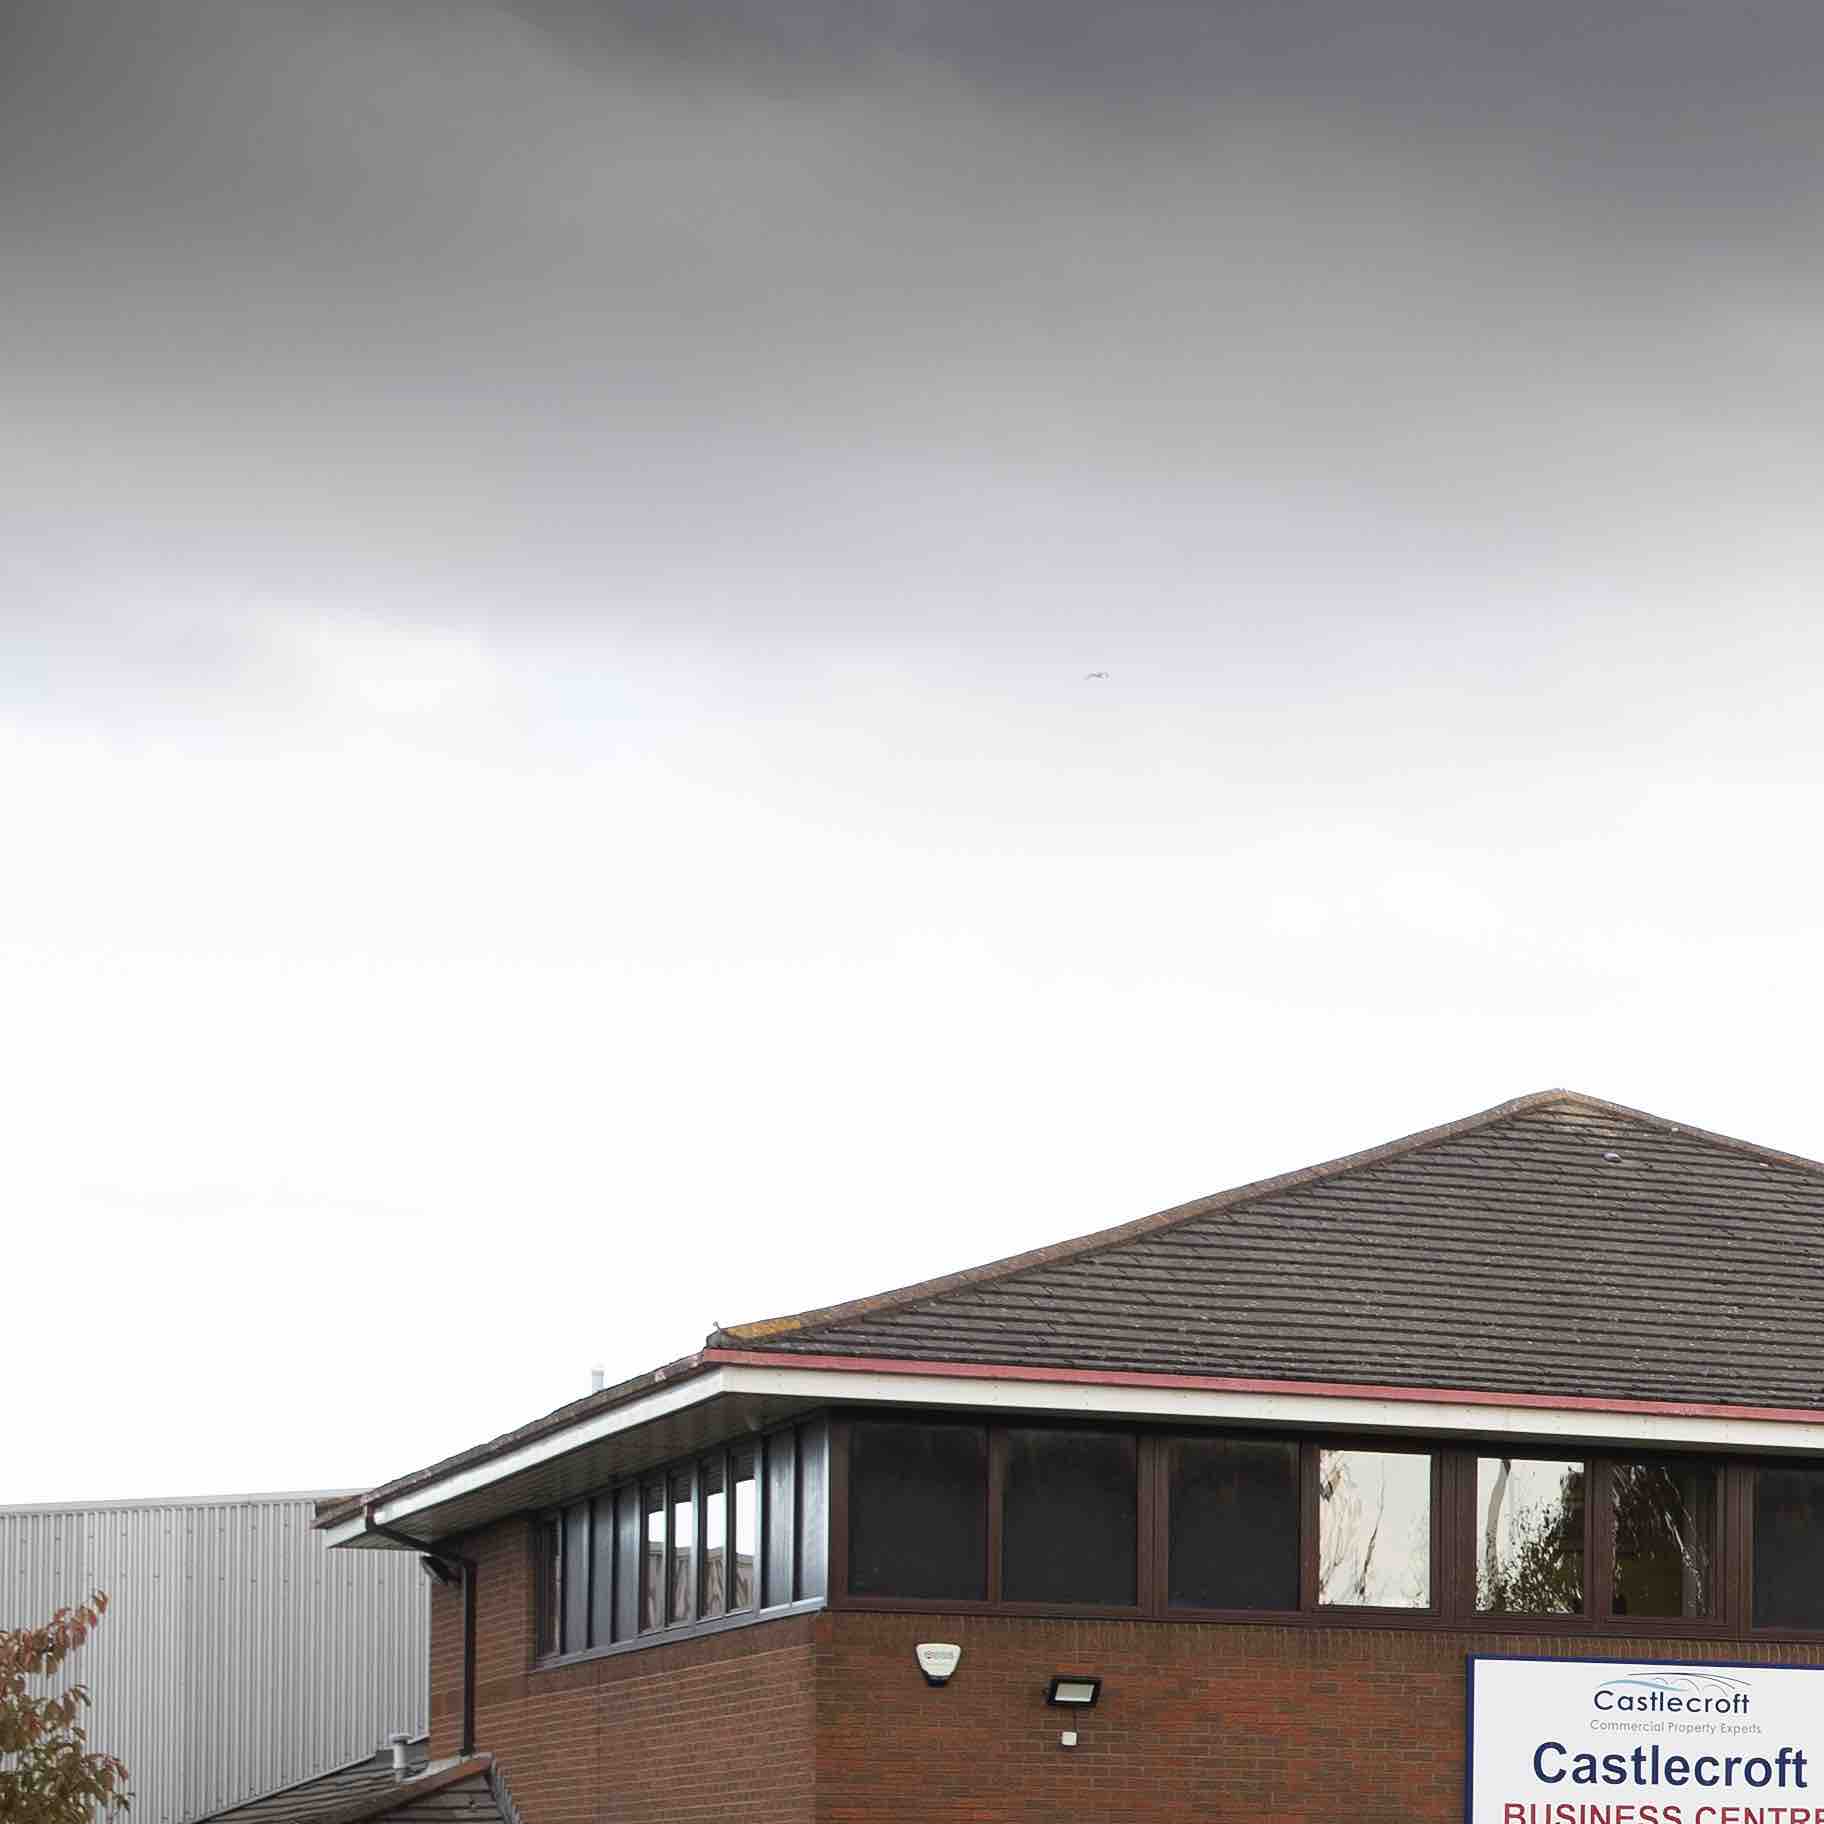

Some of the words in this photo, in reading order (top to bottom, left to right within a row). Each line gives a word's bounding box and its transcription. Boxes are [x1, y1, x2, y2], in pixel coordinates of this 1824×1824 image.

[1593, 1690, 1750, 1714] Castlecroft
[1590, 1719, 1665, 1733] Commercial
[1668, 1721, 1717, 1735] Property
[1720, 1723, 1762, 1736] Experts
[1533, 1741, 1807, 1788] Castlecroft
